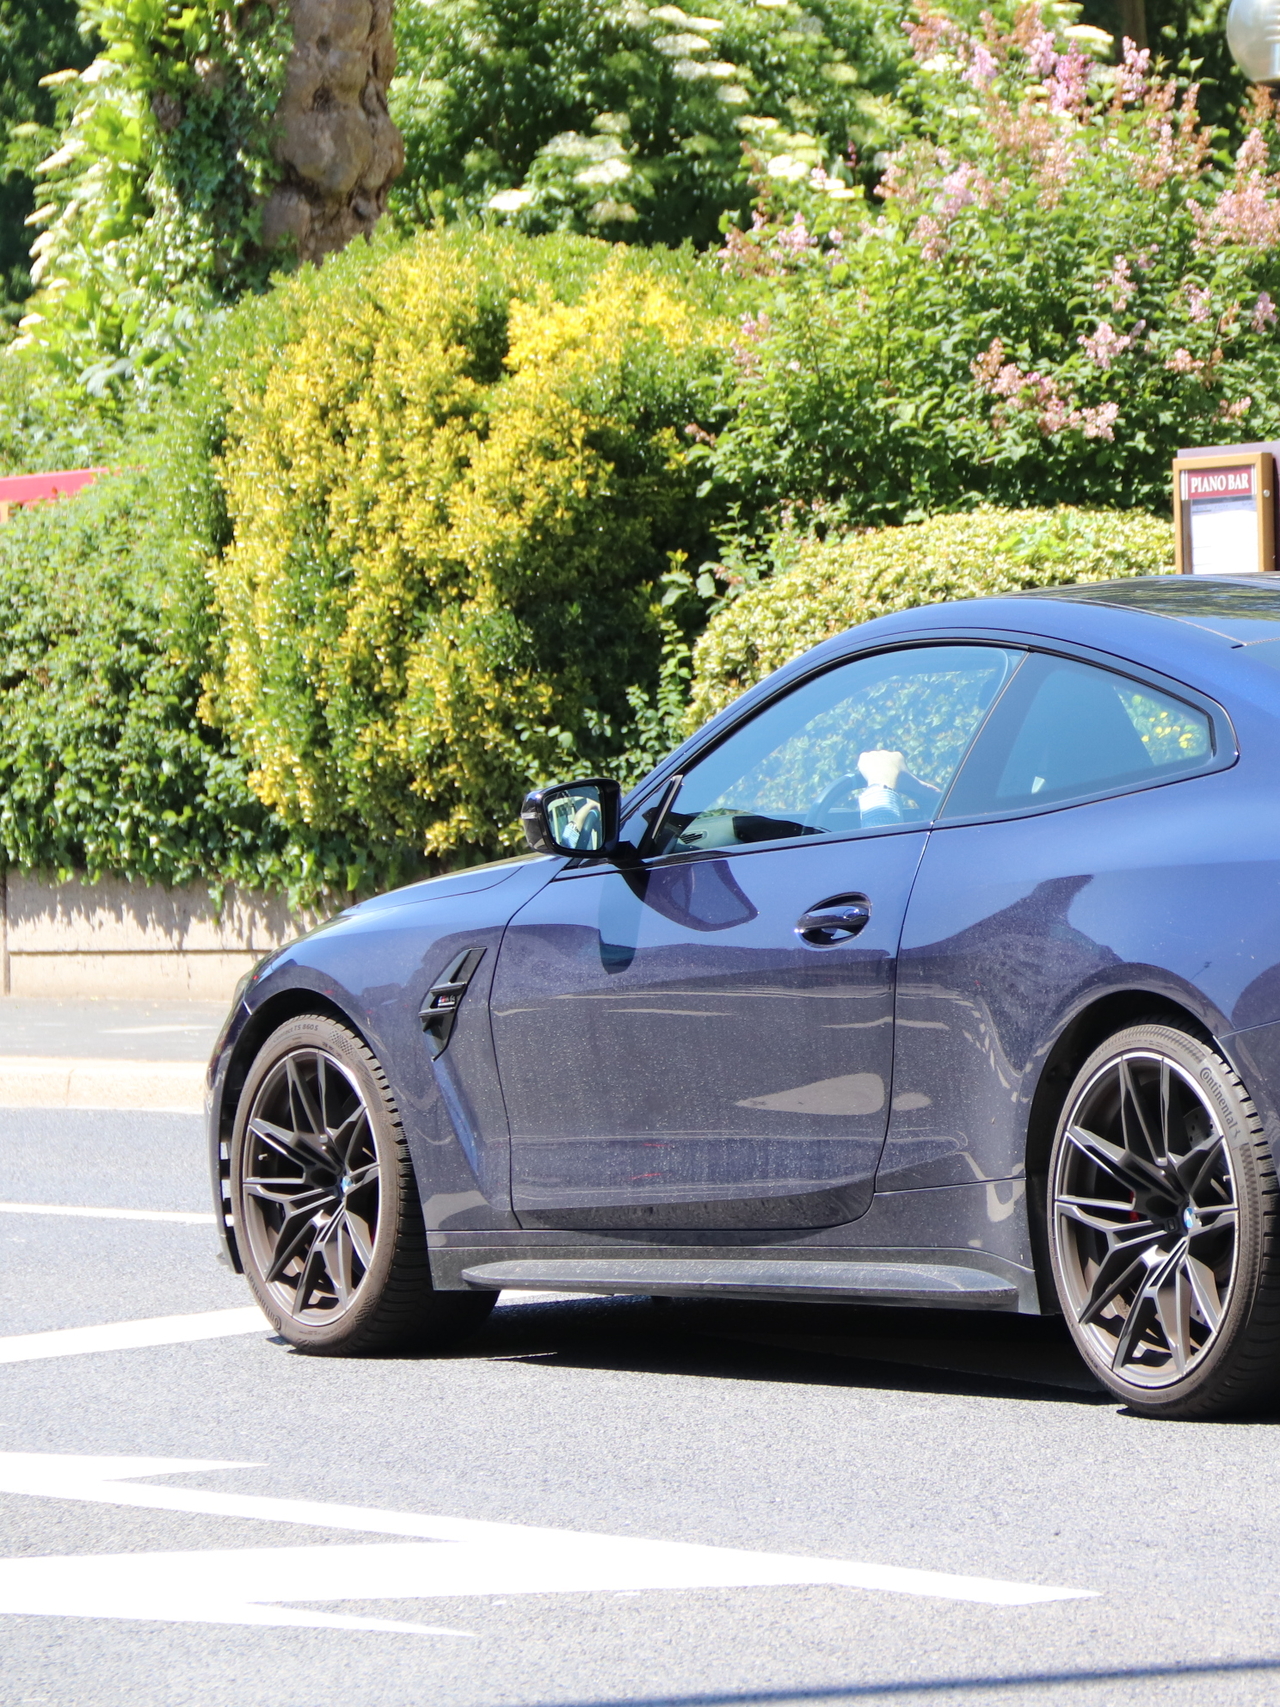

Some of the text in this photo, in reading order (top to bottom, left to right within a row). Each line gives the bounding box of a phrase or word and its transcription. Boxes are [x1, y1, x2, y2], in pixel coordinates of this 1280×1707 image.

[1190, 473, 1249, 493] PIANO BAR
[1199, 1066, 1238, 1130] Continental
